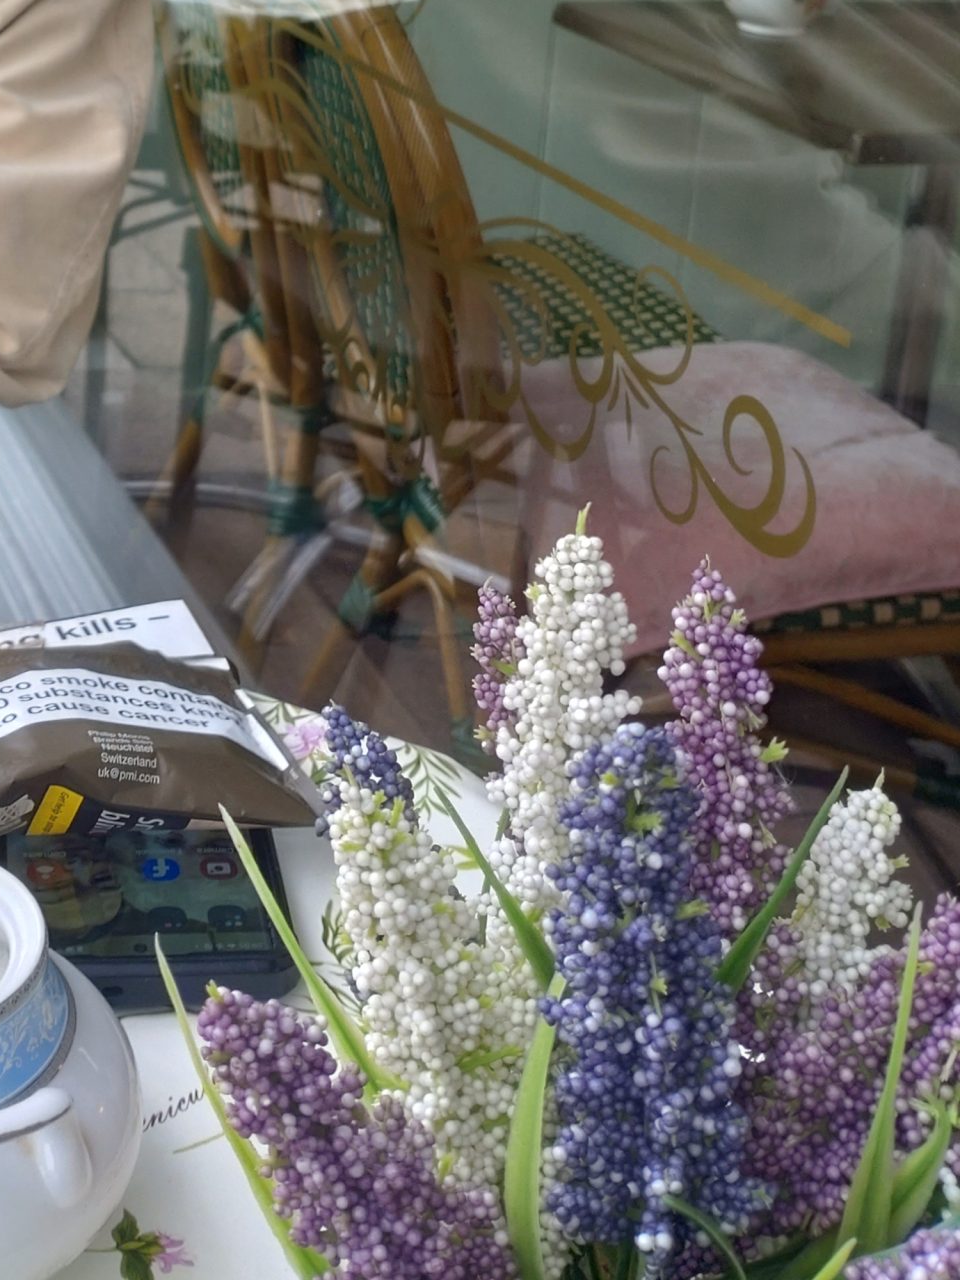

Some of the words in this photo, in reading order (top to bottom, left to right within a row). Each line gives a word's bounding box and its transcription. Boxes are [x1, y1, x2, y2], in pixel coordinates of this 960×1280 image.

[55, 614, 138, 641] kills
[18, 686, 175, 713] substances
[40, 674, 130, 693] smoke
[138, 681, 240, 718] contain
[27, 699, 110, 716] cause
[117, 708, 210, 728] cancer
[100, 751, 158, 769] Switzerland
[97, 766, 161, 785] uk@pmi.com
